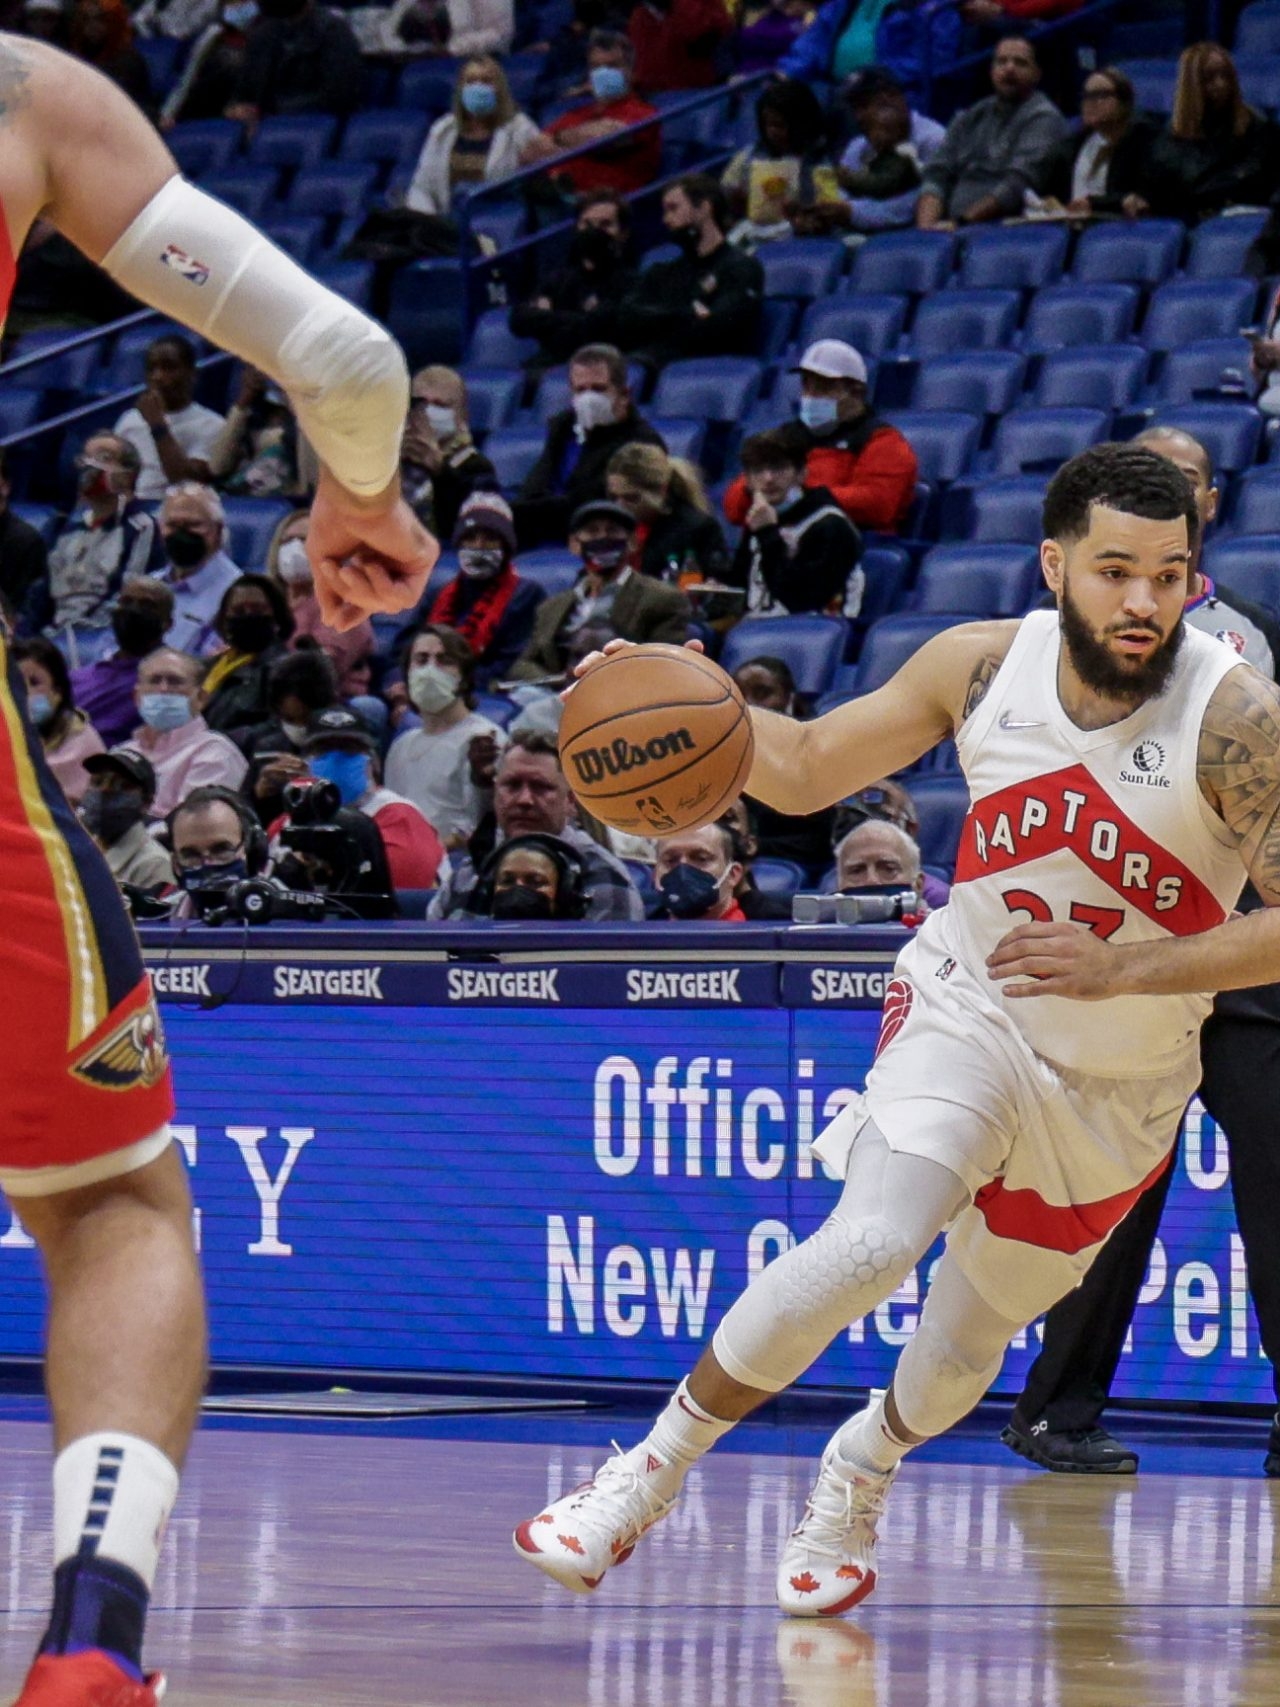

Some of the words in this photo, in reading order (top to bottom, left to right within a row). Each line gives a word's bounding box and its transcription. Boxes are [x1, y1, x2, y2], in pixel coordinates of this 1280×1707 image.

[571, 727, 696, 784] Wilson
[1119, 770, 1144, 785] Sun
[1147, 774, 1171, 788] Life
[972, 788, 1184, 912] RAPTORS
[273, 965, 384, 1000] SEATGEEK
[447, 967, 560, 1002] SEATGEEK
[626, 968, 742, 1003] SEATGEEK
[547, 1215, 716, 1338] New
